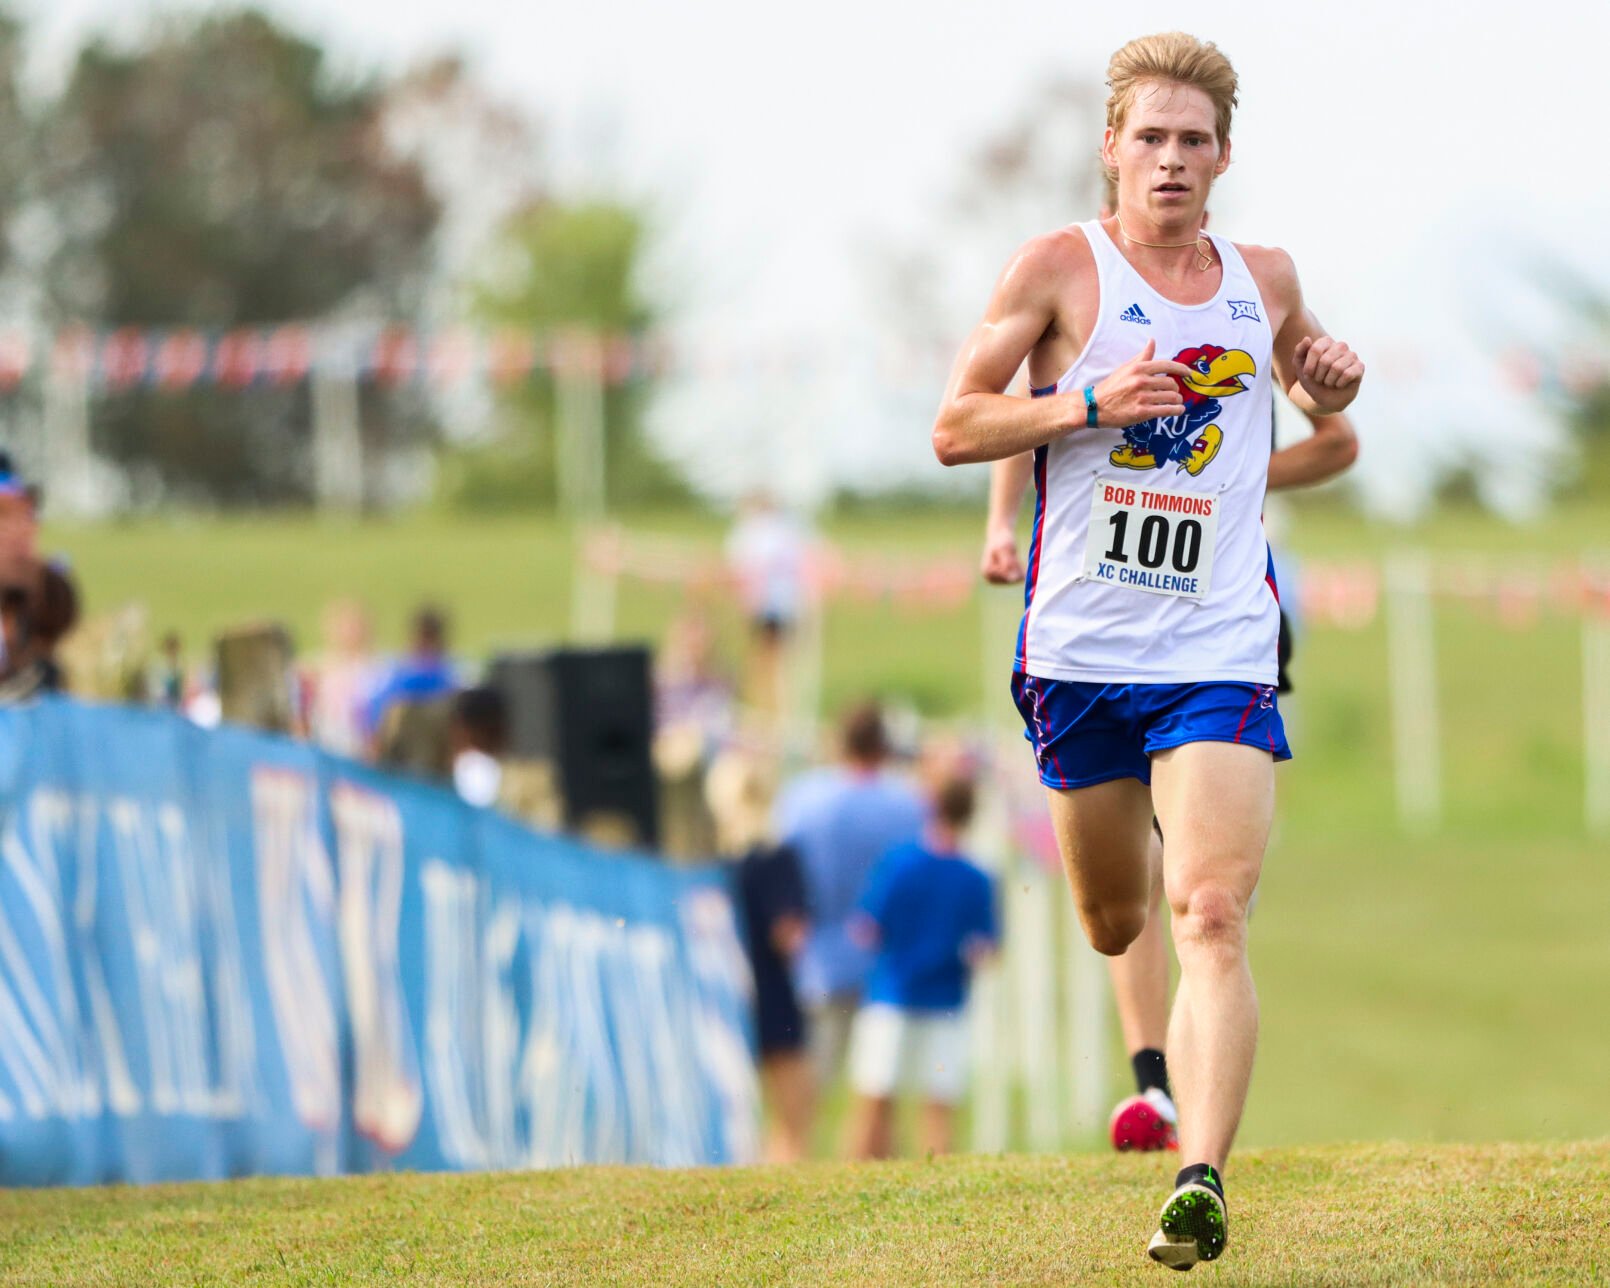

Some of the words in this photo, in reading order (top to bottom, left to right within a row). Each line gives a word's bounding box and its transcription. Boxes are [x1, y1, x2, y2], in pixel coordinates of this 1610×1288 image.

[1120, 314, 1151, 325] adidas
[1154, 415, 1188, 438] KU
[1104, 486, 1136, 506] BOB
[1141, 492, 1213, 516] TIMMONS
[1105, 510, 1202, 573] 100
[1097, 563, 1115, 579] XC
[1119, 568, 1198, 593] CHALLENGE
